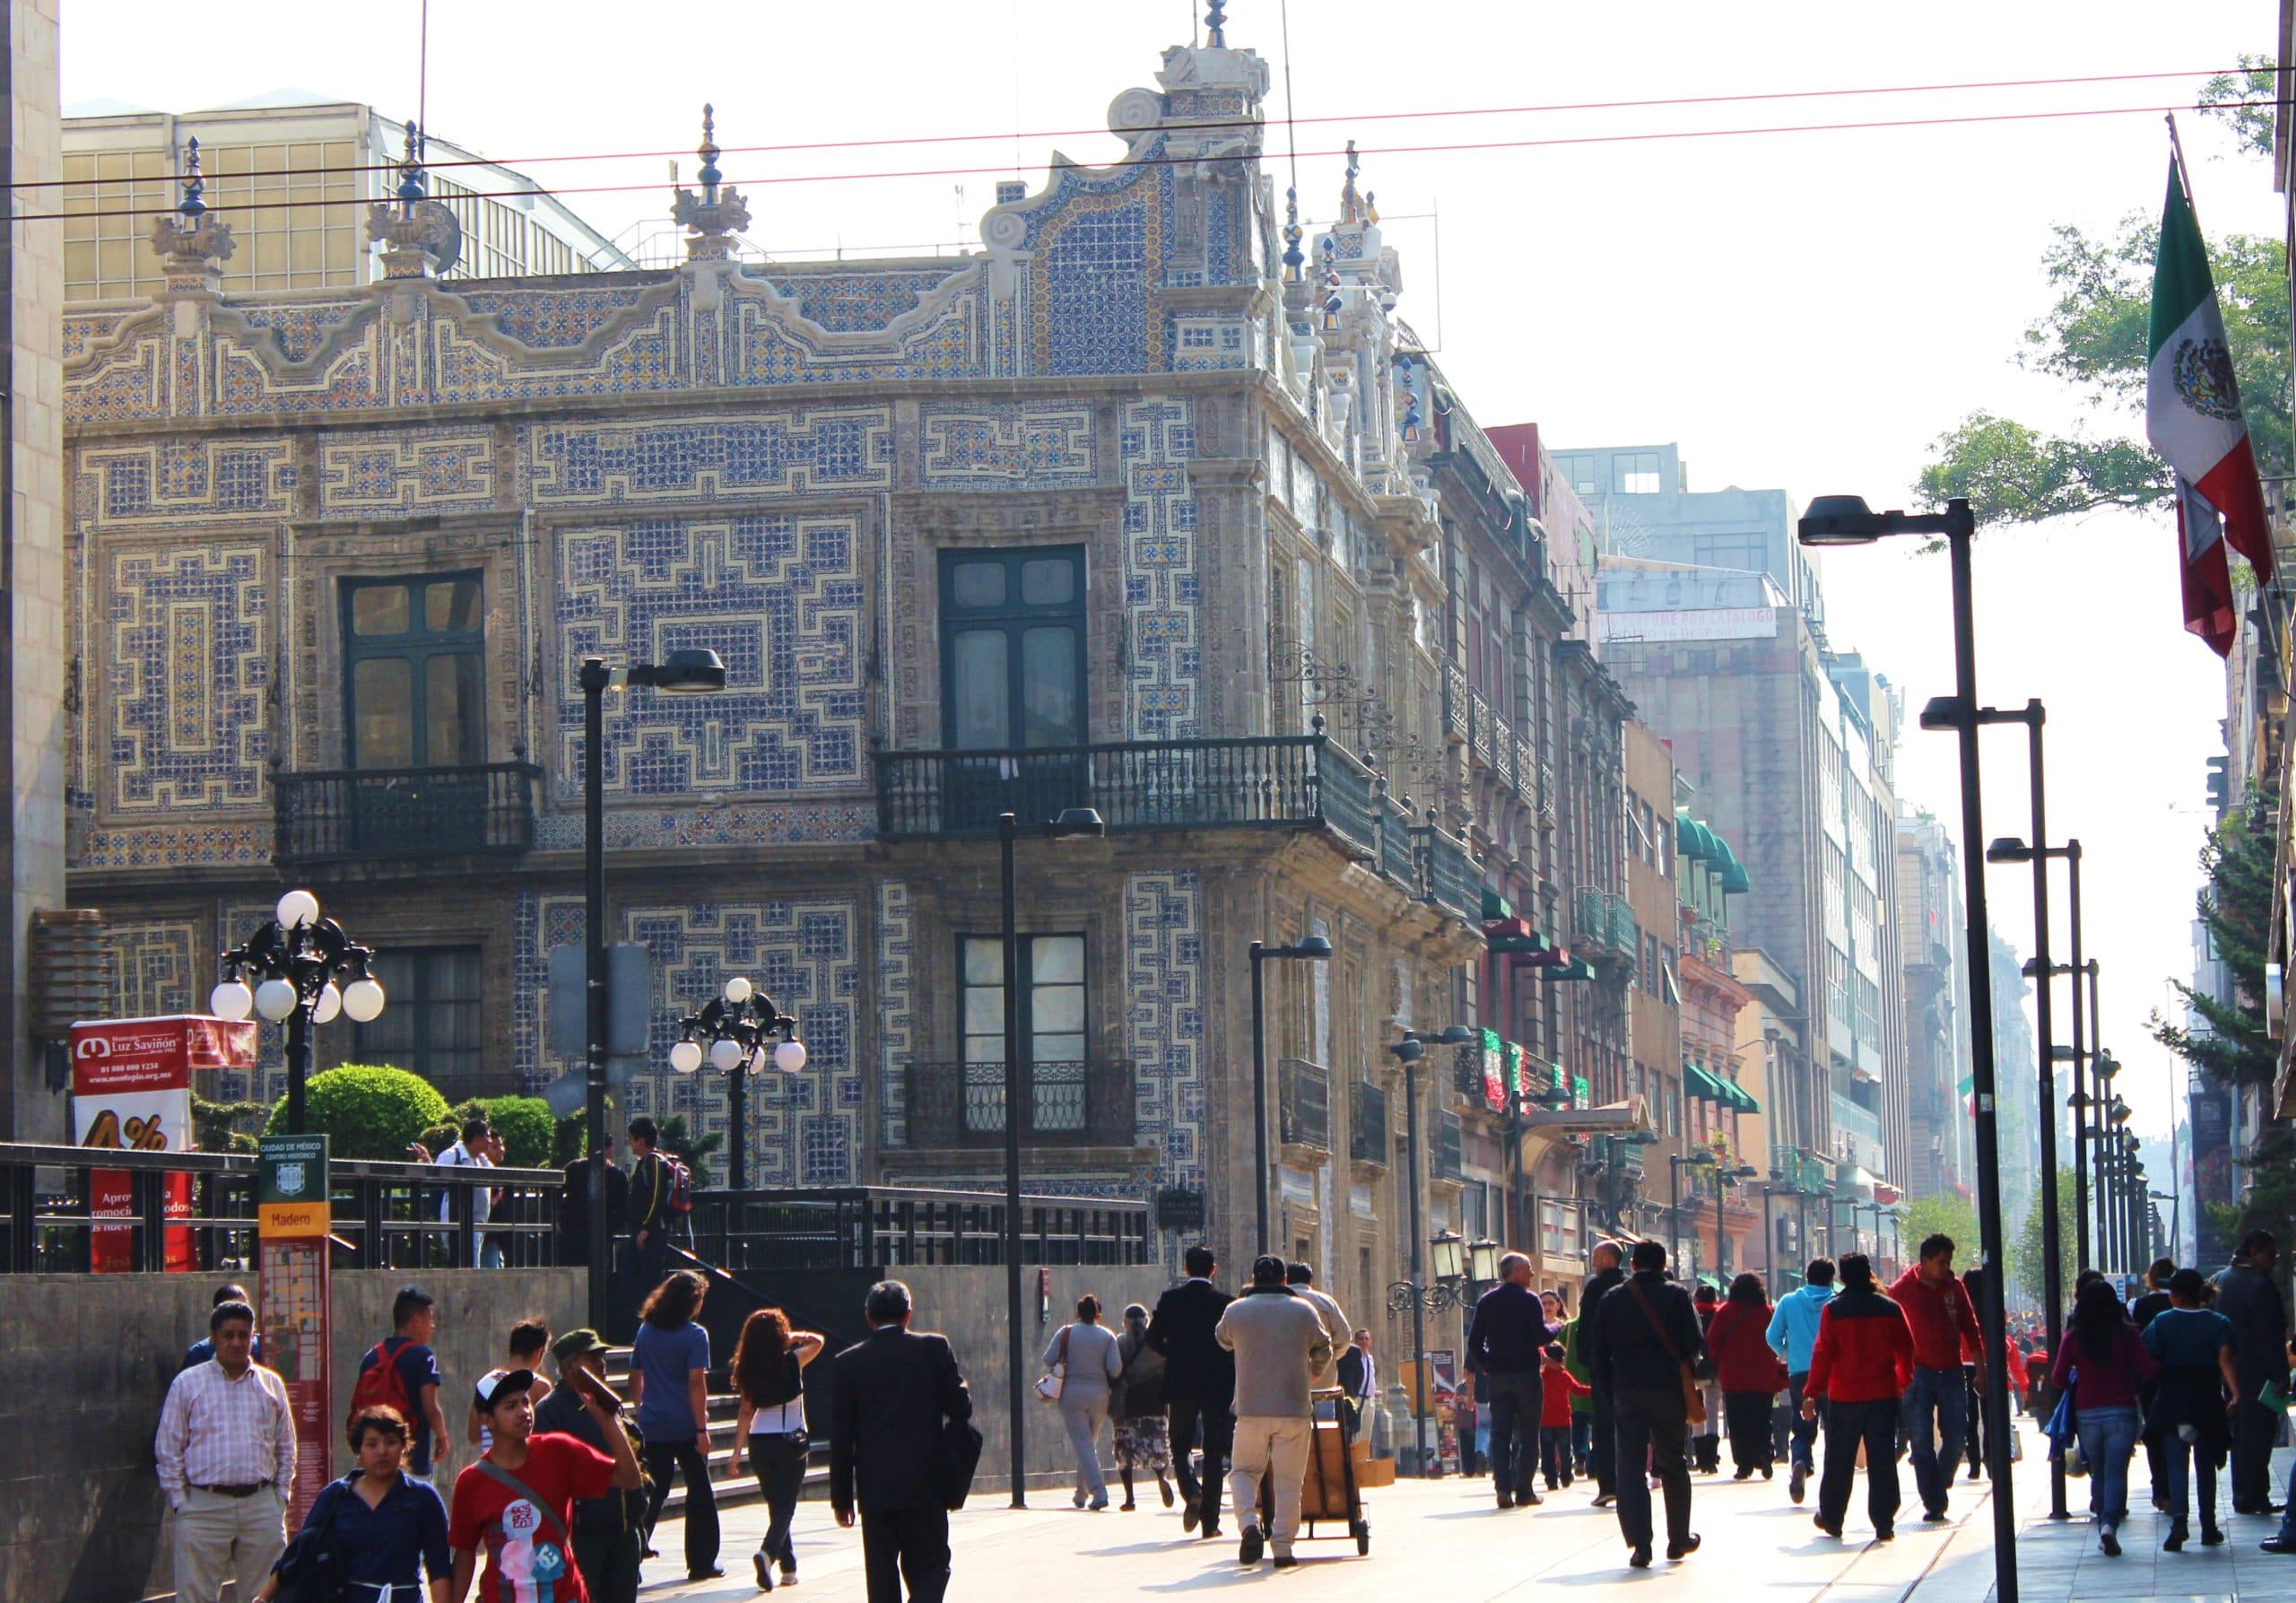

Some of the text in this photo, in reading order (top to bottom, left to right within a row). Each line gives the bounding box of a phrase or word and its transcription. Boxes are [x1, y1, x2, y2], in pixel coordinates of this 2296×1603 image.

[112, 1037, 176, 1052] Luz Saviñón
[142, 1062, 159, 1070] 1234
[89, 1072, 172, 1084] www.montepio.org.mx
[260, 1140, 321, 1153] CIUDAD DE MÉXICO
[265, 1153, 287, 1161] CENTRO
[91, 1201, 190, 1218] romoci odos
[272, 1212, 310, 1228] Madero
[427, 1355, 441, 1374] 2
